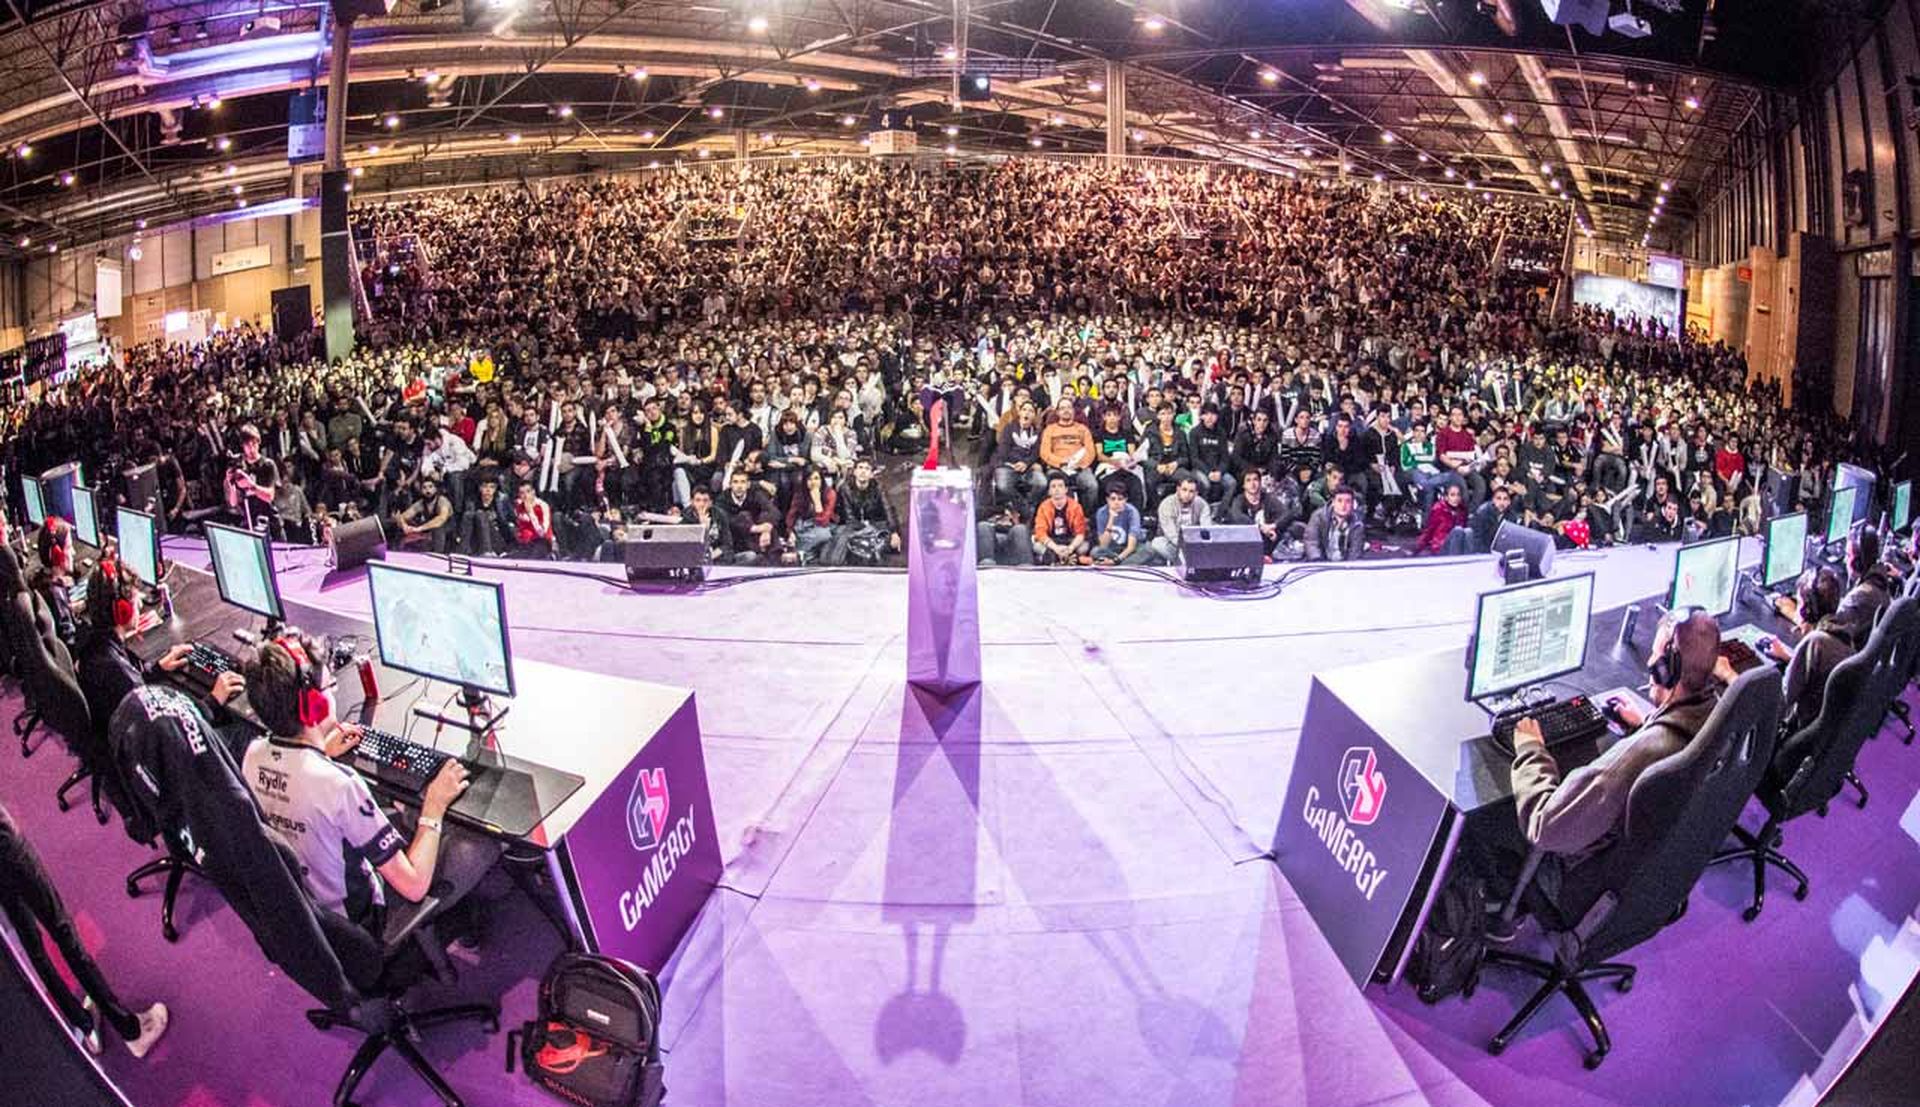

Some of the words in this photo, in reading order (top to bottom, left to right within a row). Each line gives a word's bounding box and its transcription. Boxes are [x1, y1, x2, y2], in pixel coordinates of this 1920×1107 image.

[881, 113, 889, 128] 4
[905, 115, 912, 129] 4
[258, 770, 288, 793] Rydle
